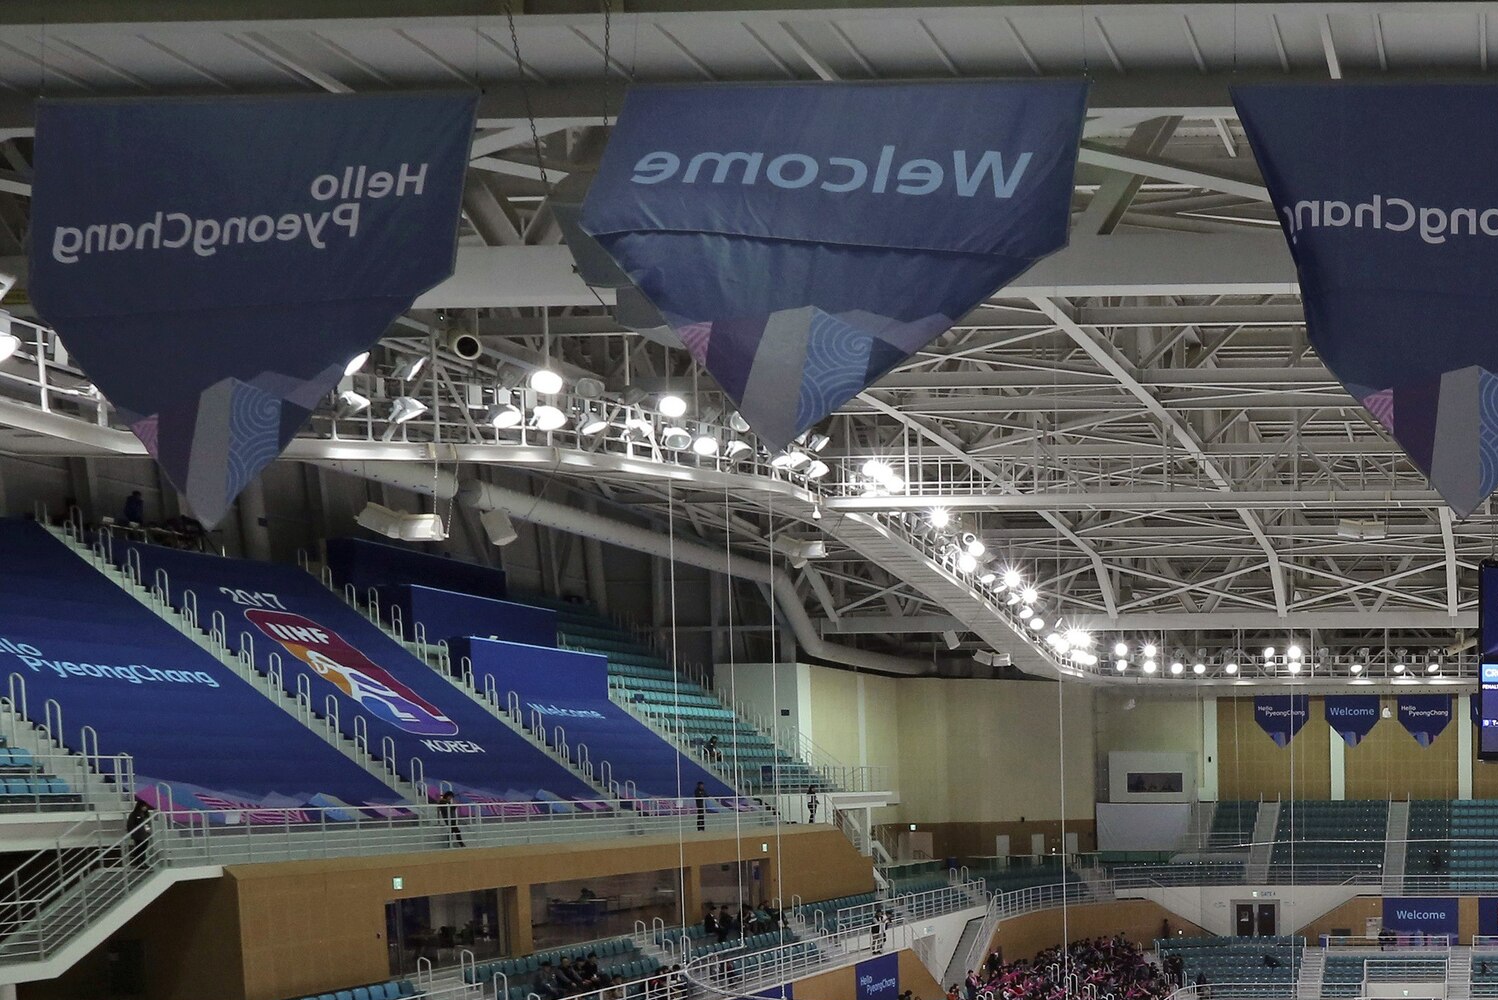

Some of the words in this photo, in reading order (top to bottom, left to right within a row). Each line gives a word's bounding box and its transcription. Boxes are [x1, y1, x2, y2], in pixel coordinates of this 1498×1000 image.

[219, 586, 287, 611] 2017
[265, 622, 330, 645] IIHF
[0, 637, 42, 657] llo
[16, 654, 220, 688] PyeongChang
[526, 702, 606, 719] Welcome
[1266, 709, 1305, 717] PyeongChang
[1330, 707, 1375, 716] Welcome
[1409, 709, 1449, 717] PyeongChang
[420, 738, 486, 753] KOREA
[1396, 910, 1446, 920] Welcome
[867, 978, 896, 995] PyeongChang
